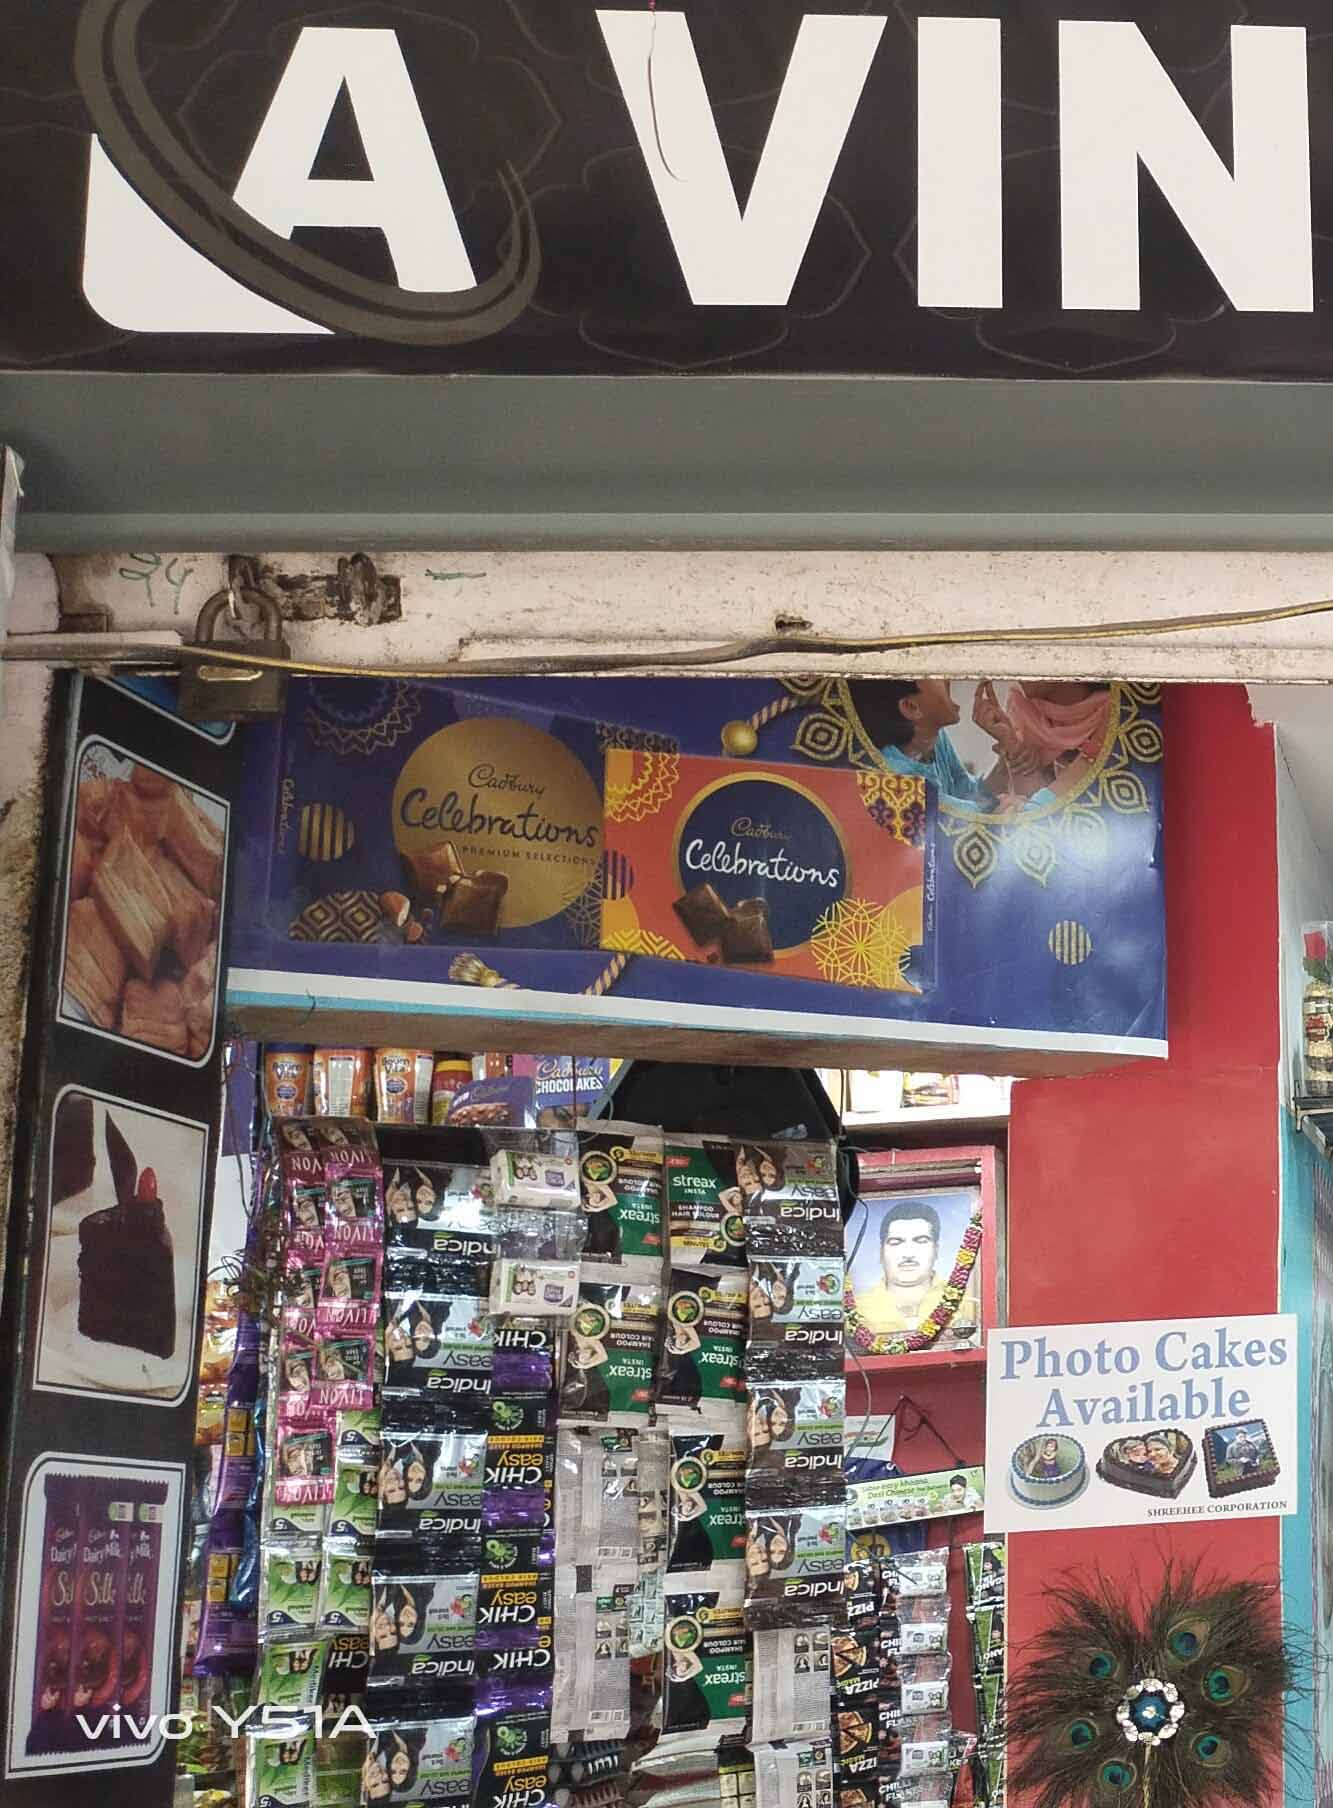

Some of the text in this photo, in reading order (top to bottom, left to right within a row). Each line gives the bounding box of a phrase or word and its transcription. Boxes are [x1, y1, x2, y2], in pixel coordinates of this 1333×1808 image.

[467, 762, 546, 797] Cadbury
[401, 788, 599, 850] Celebrations
[462, 845, 525, 860] PREMIUM
[685, 838, 840, 890] Celebrations
[672, 1175, 717, 1189] streax
[618, 1208, 660, 1225] streax
[780, 1207, 840, 1222] Indica
[785, 1329, 843, 1345] Indica
[1000, 1328, 1288, 1380] Photo Cakes
[608, 1364, 653, 1381] streax
[426, 1376, 492, 1395] Indica
[1035, 1376, 1251, 1428] Available
[496, 1451, 545, 1467] easy
[784, 1455, 843, 1469] Indica
[486, 1466, 543, 1485] CHIK
[1206, 1501, 1288, 1514] CORPORATION
[419, 1517, 481, 1534] Indica
[709, 1514, 745, 1526] treax
[783, 1579, 845, 1598] Indica
[491, 1589, 538, 1606] easy
[479, 1605, 536, 1624] CHIK
[847, 1602, 875, 1618] PIZZ
[328, 1650, 369, 1669] CHI
[411, 1659, 476, 1677] Indica
[493, 1650, 551, 1670] CHIK
[844, 1677, 880, 1696] PIZZA
[849, 1756, 878, 1774] IZZA
[421, 1779, 472, 1796] easy
[505, 1775, 548, 1791] easy
[493, 1788, 545, 1808] CHIK
